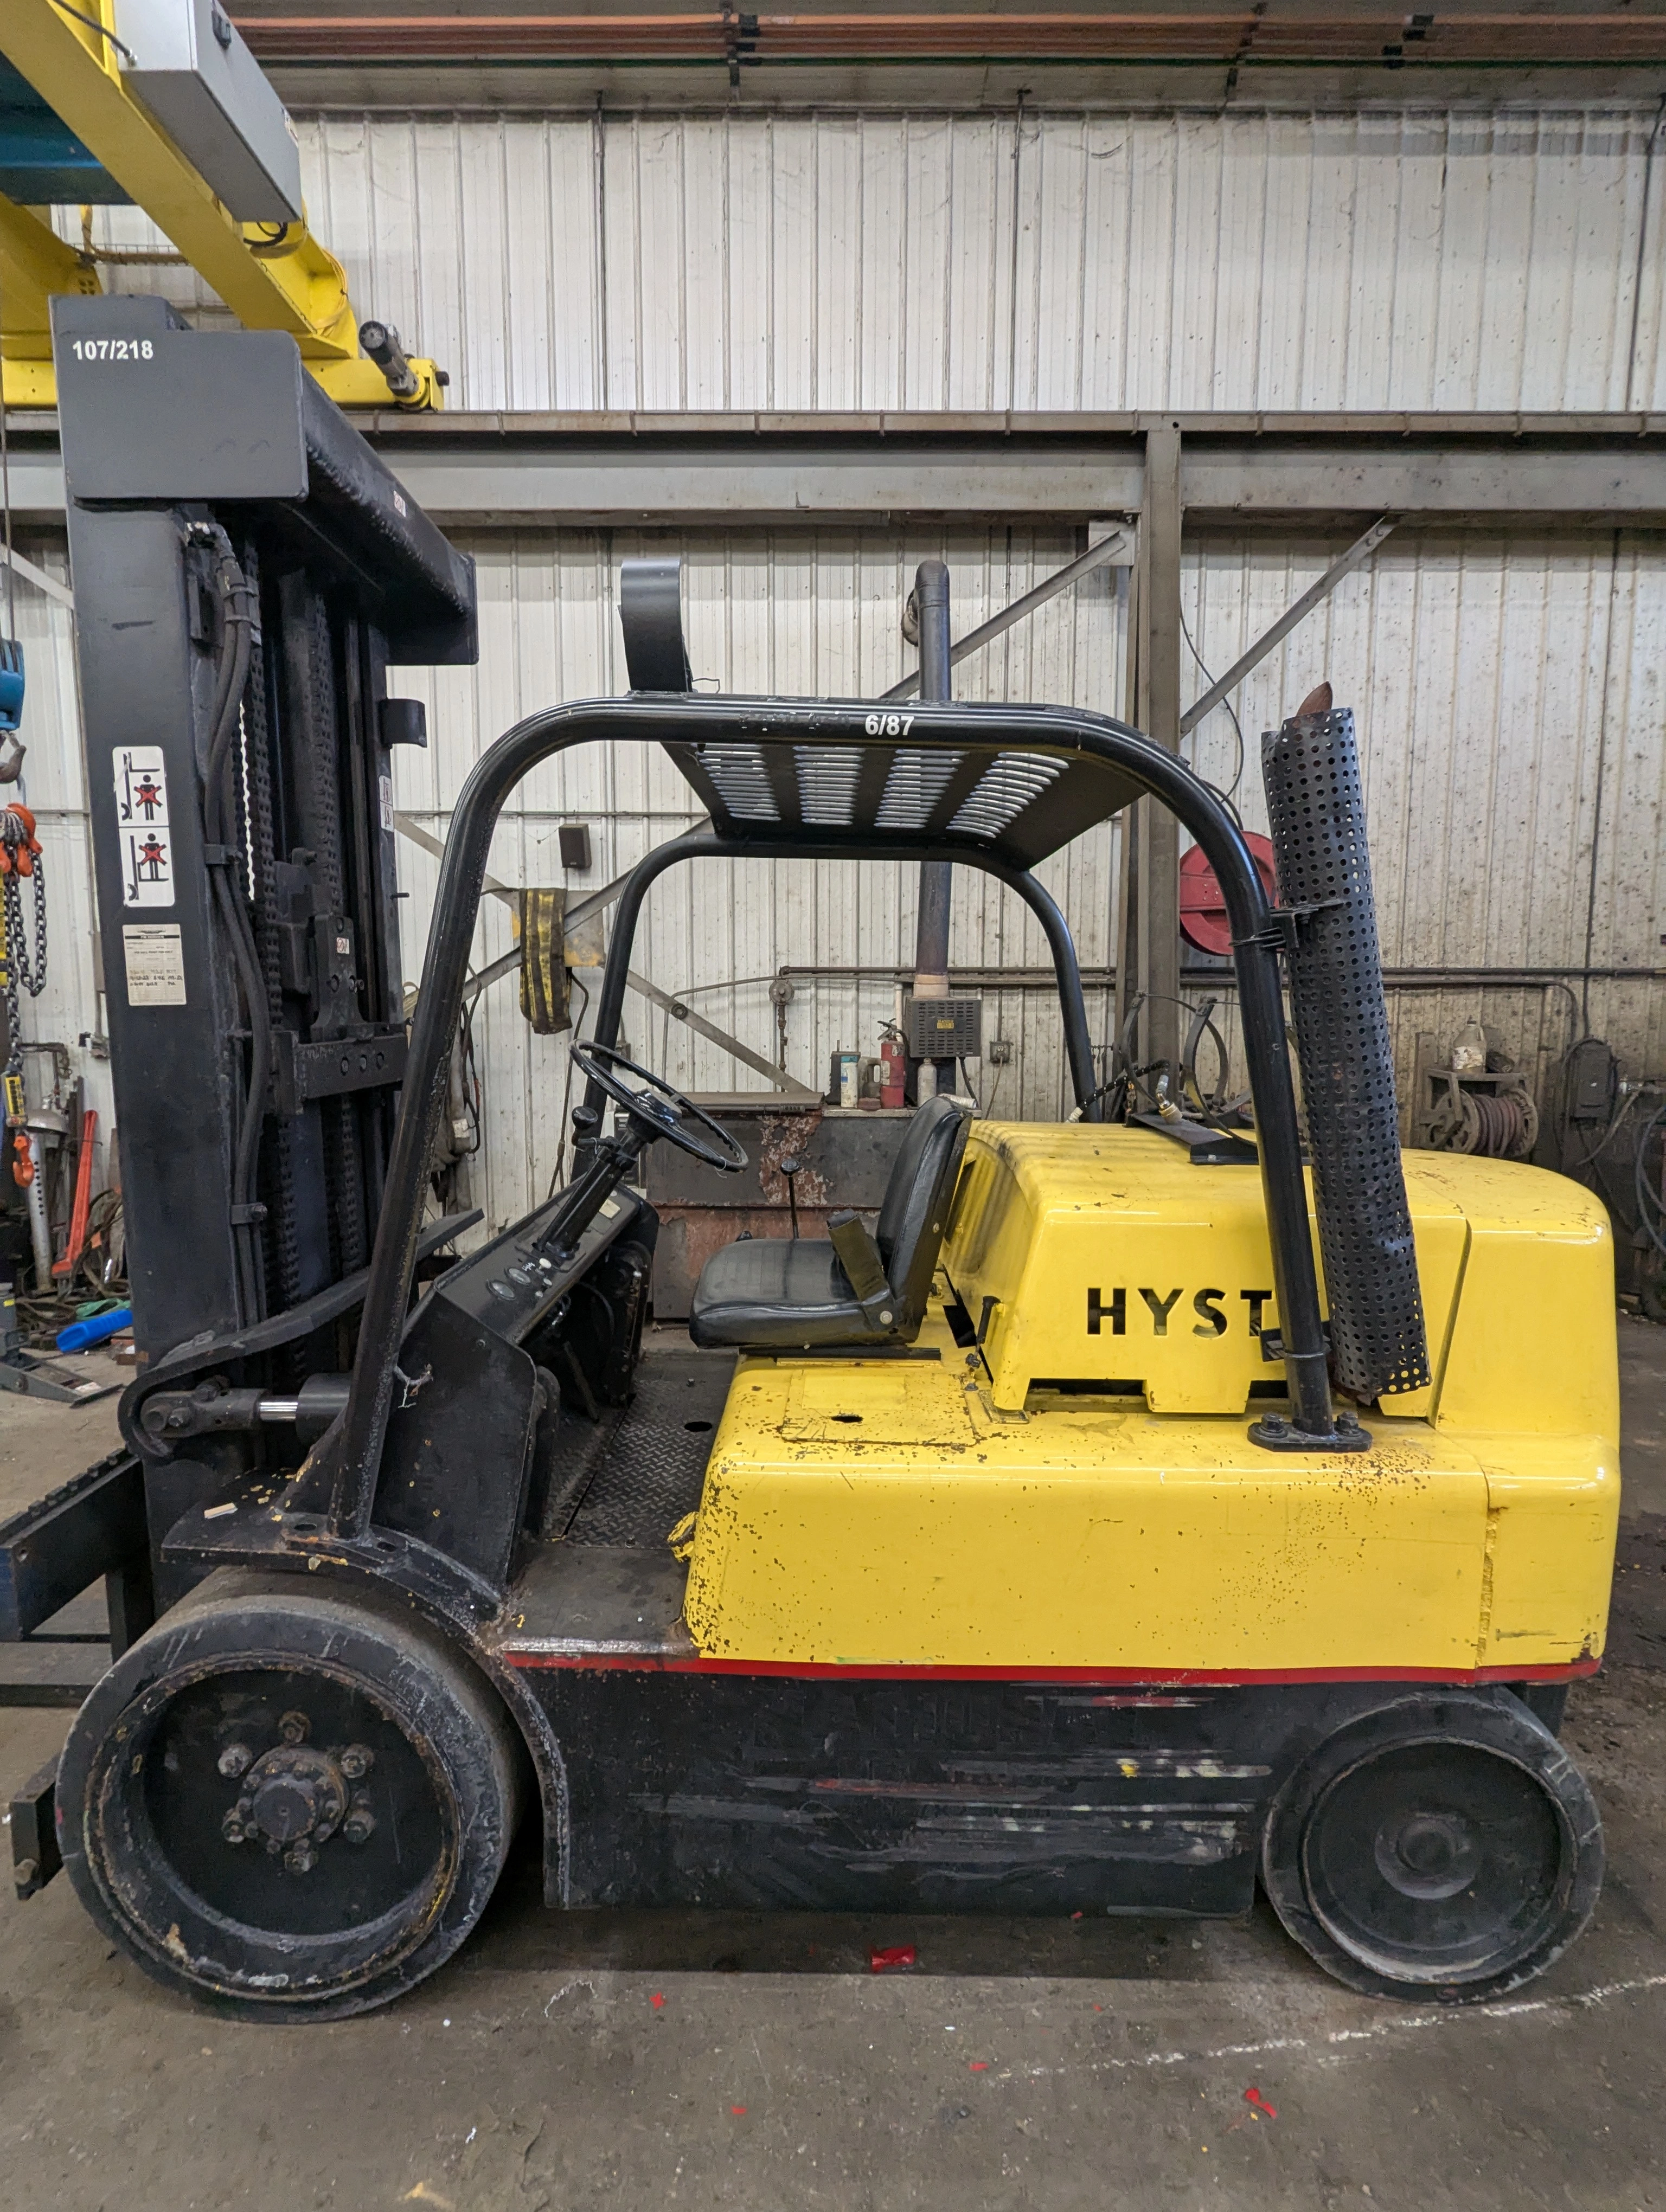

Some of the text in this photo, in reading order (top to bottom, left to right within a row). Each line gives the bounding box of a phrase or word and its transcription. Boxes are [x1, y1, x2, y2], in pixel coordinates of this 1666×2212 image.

[73, 340, 153, 360] 107/218
[865, 715, 915, 736] 6/87
[1087, 1288, 1272, 1339] HYST
